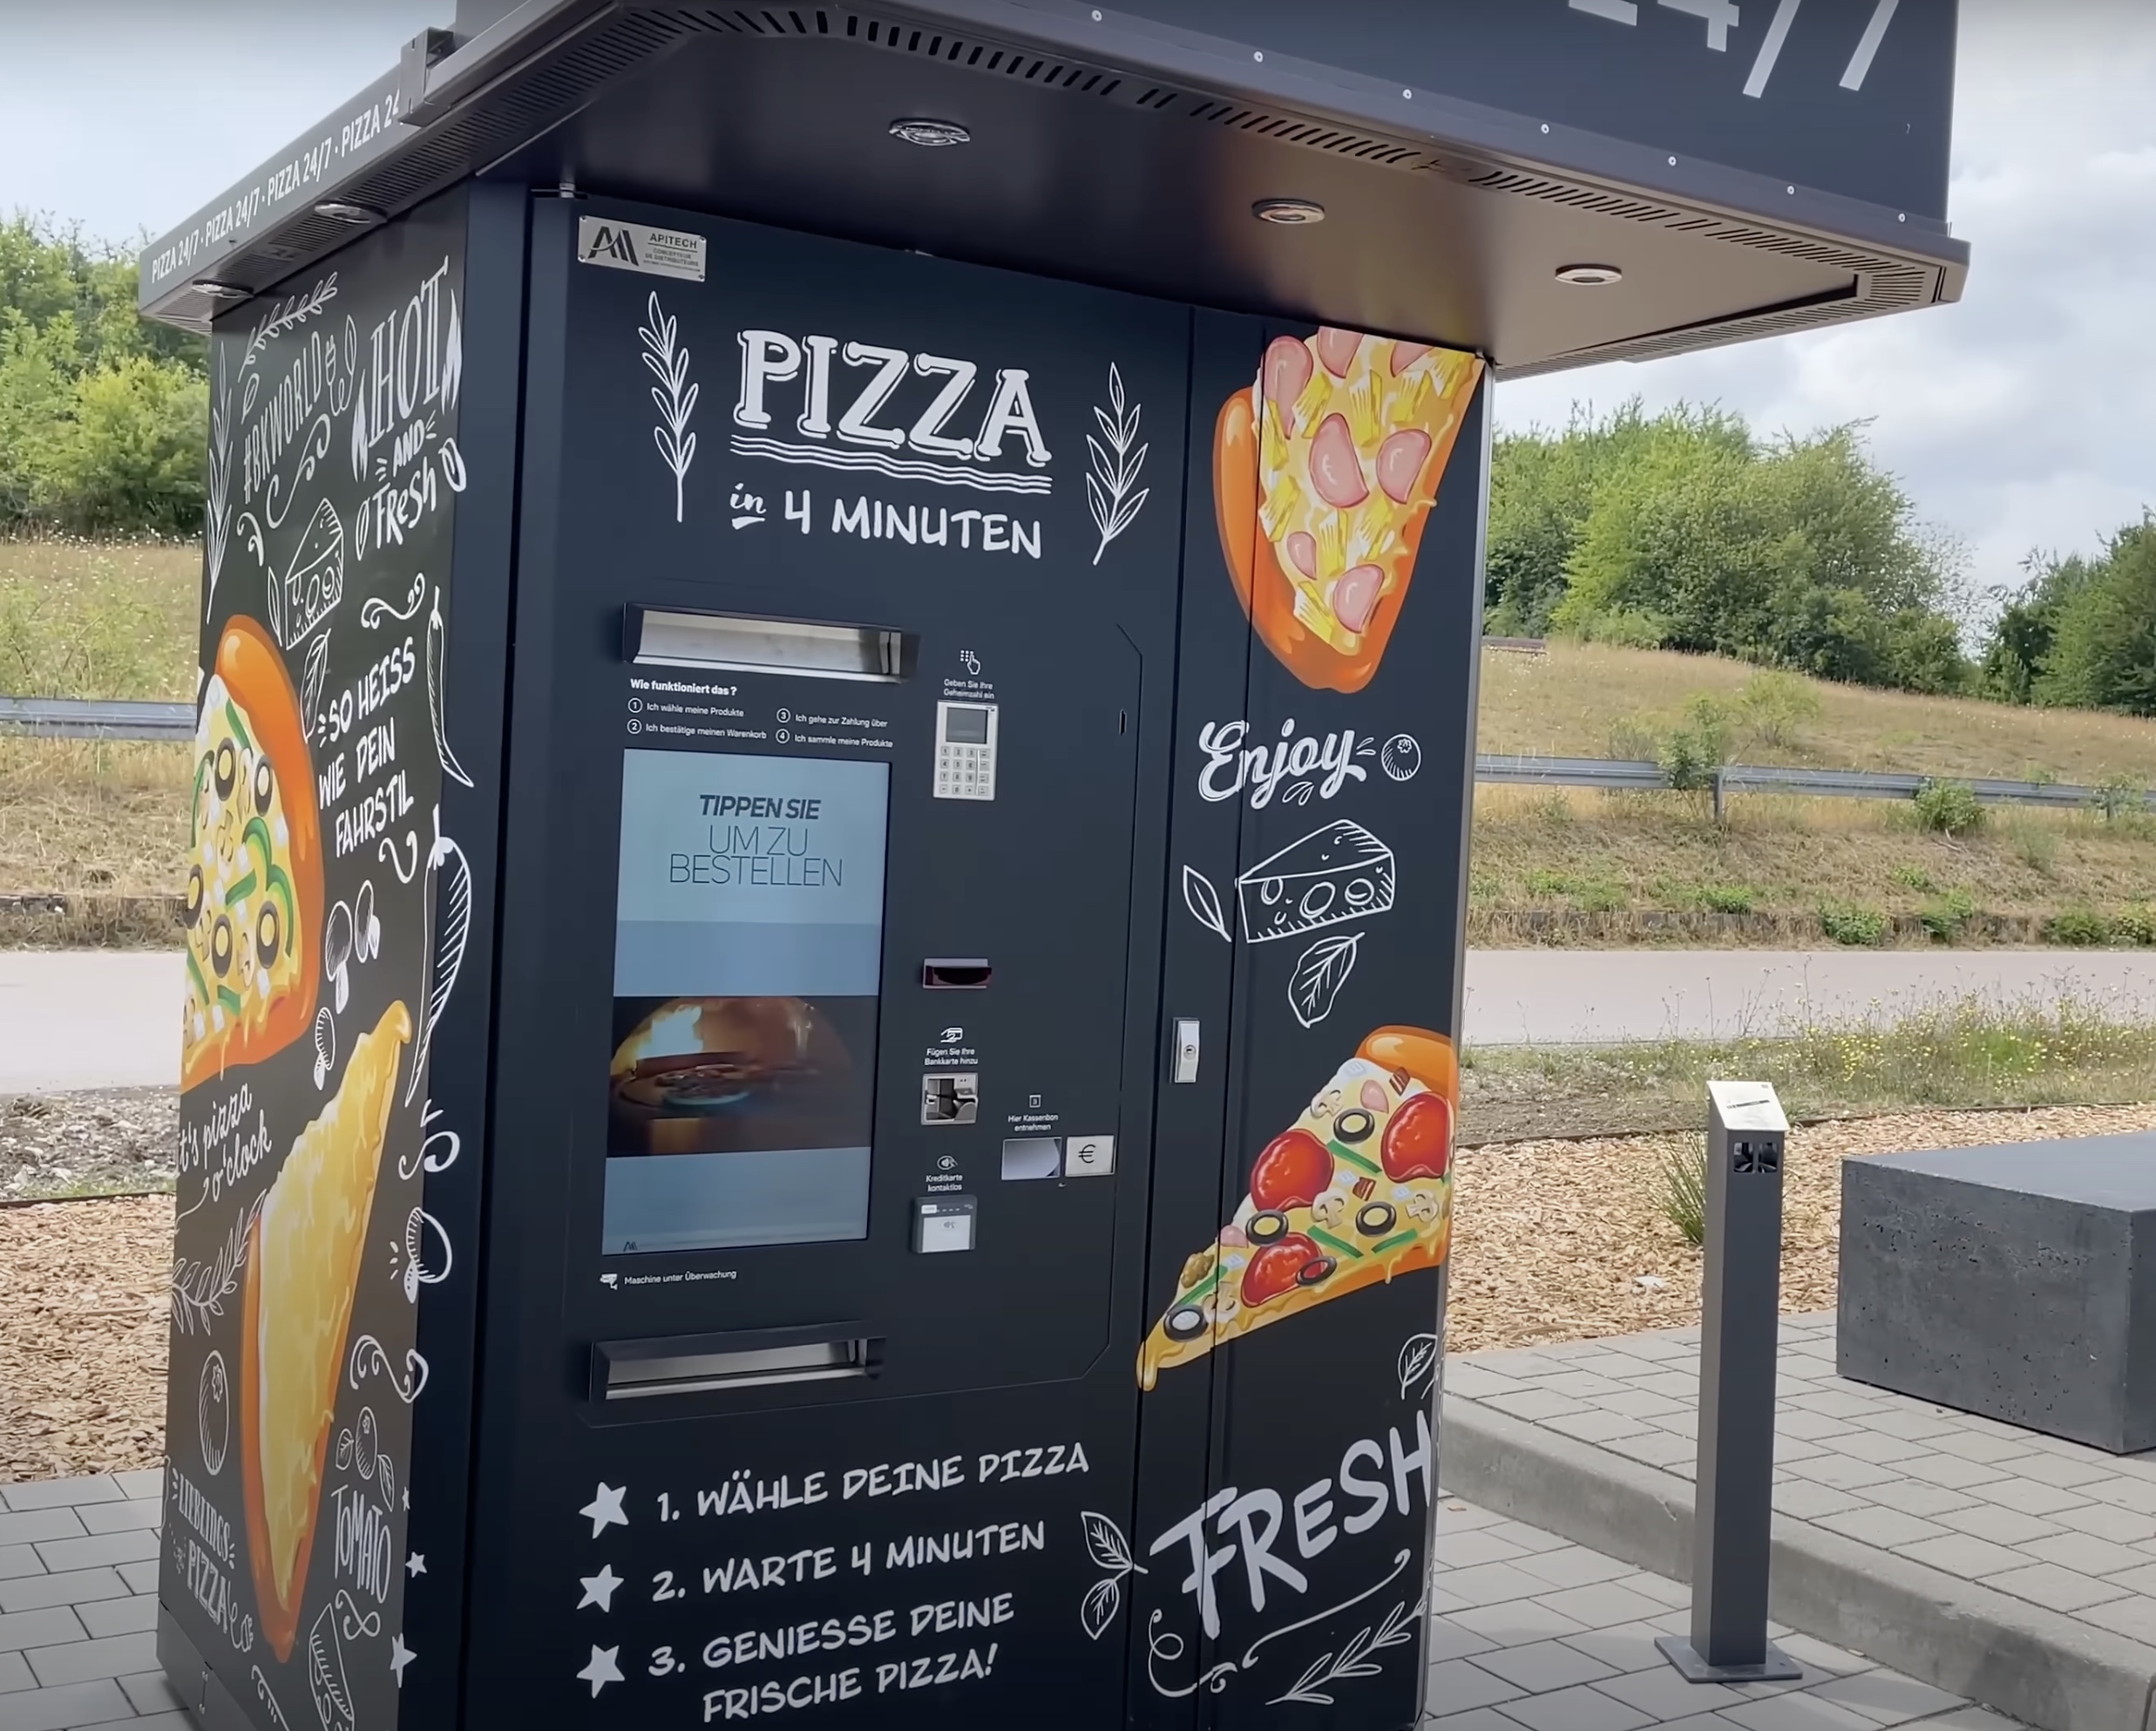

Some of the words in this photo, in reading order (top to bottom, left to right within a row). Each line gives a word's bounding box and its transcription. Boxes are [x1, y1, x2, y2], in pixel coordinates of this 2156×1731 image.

[152, 246, 177, 284] PIZZA
[178, 228, 200, 266] 24/7
[205, 206, 234, 248] PIZZA
[235, 187, 261, 228] 24/7
[267, 160, 301, 207] PIZZA
[302, 137, 332, 183] 24/7
[342, 104, 381, 158] PIZZA
[649, 233, 697, 249] APITECH
[369, 255, 449, 448] HOT
[243, 330, 322, 506] #BKWORLD
[733, 329, 1053, 467] PIZZA
[393, 418, 424, 478] AND
[730, 483, 766, 515] in
[784, 489, 811, 534] 4
[831, 495, 1042, 560] MINUTEN
[329, 689, 353, 742] SO
[357, 636, 417, 720] HEISS
[630, 678, 650, 690] Wie
[651, 680, 710, 695] funktioniert
[711, 685, 729, 696] das
[647, 703, 660, 711] Ich
[661, 703, 684, 713] wähle
[710, 707, 744, 717] Produkte
[795, 714, 807, 723] Ich
[808, 716, 827, 724] gehe
[841, 716, 870, 728] Zahlung
[871, 719, 889, 728] über
[944, 678, 966, 688] Geben
[967, 680, 979, 689] Sie
[980, 681, 993, 689] Ihre
[318, 752, 347, 811] WIE
[356, 716, 396, 784] DEIN
[646, 723, 658, 732] Ich
[660, 724, 695, 737] bestätige
[697, 728, 726, 737] meinen
[726, 729, 767, 739] Warenkorb
[794, 734, 806, 743] Ich
[808, 736, 837, 744] sammle
[861, 738, 893, 748] Produkte
[1197, 717, 1367, 810] Enjoy
[335, 769, 415, 859] FAHRSTIL
[700, 794, 783, 818] TIPPEN
[785, 798, 822, 819] SIE
[709, 825, 759, 855] UM
[766, 826, 809, 857] ZU
[669, 853, 843, 886] BESTELLEN
[925, 1057, 959, 1066] Bankkarte
[926, 1048, 948, 1057] Fügen
[203, 1083, 252, 1170] pizza
[212, 1109, 272, 1203] o'clock
[1023, 1113, 1059, 1123] Kassenbon
[925, 1174, 963, 1183] Kreditkarte
[624, 1274, 661, 1285] Maschine
[662, 1273, 683, 1283] unter
[684, 1270, 737, 1281] Überwachung
[178, 1473, 231, 1562] LIEBLINGS
[656, 1492, 681, 1523] 1.
[696, 1469, 829, 1517] WÄHLE
[842, 1455, 965, 1500] DEINE
[978, 1442, 1090, 1483] PIZZA
[330, 1483, 392, 1605] TOMATO
[651, 1571, 686, 1602] 2.
[702, 1545, 837, 1595] WARTE
[851, 1541, 873, 1576] 4
[885, 1519, 1046, 1571] MINUTEN
[1149, 1409, 1432, 1640] FRESH
[186, 1538, 228, 1634] PIZZA
[648, 1645, 686, 1677] 3.
[702, 1609, 898, 1669] GENIESSE
[911, 1592, 1015, 1638] DEINE
[702, 1667, 863, 1724] FRISCHE
[876, 1642, 1000, 1694] PIZZA!
